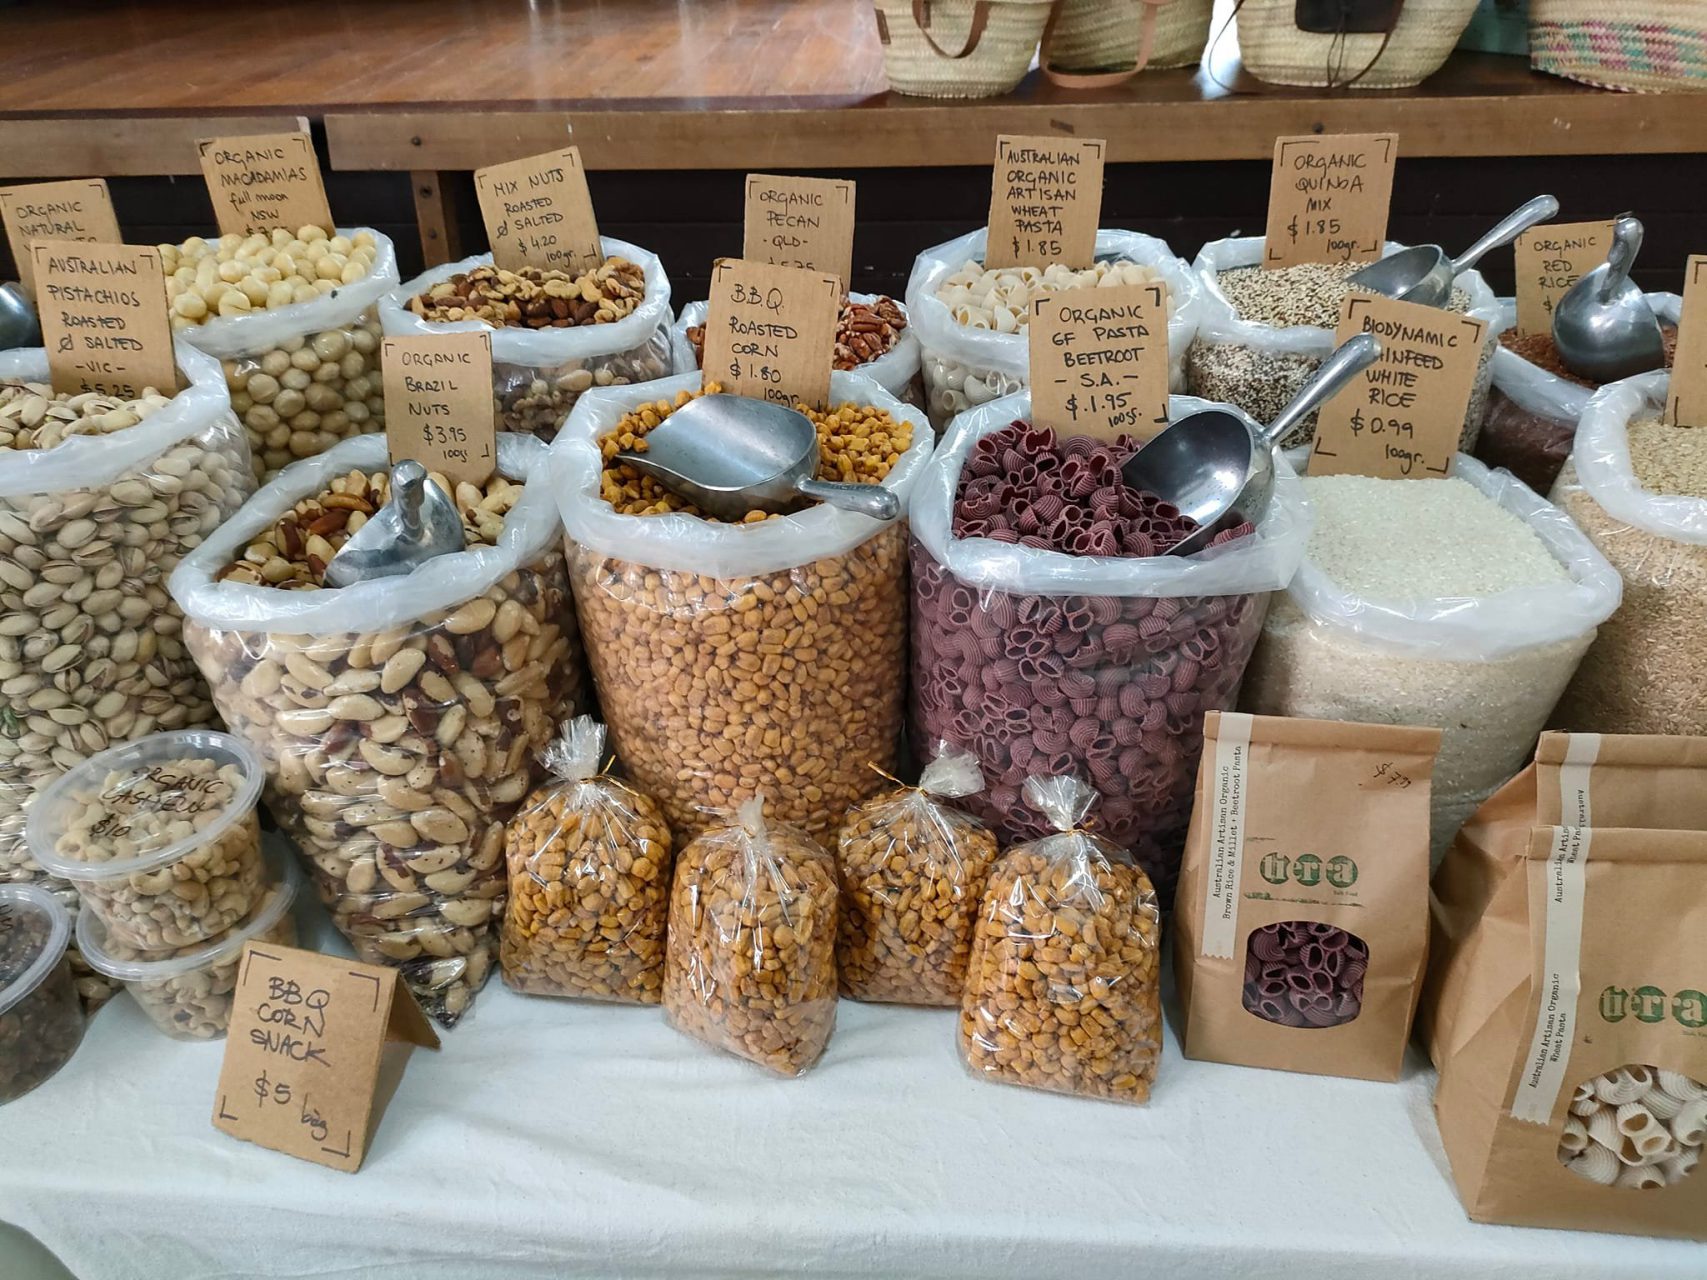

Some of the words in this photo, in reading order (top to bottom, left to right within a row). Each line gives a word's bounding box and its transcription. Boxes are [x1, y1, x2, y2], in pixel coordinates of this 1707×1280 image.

[215, 149, 285, 170] ORGANIC
[1007, 149, 1080, 166] AUSTRALIAN
[1294, 153, 1366, 177] ORGANIC
[221, 167, 307, 187] MACADAMIAS
[493, 180, 519, 197] MIX
[528, 168, 564, 189] NUTS
[1006, 170, 1077, 189] ORGANIC
[1295, 175, 1364, 194] QUINOA
[230, 190, 252, 212] full
[256, 192, 289, 203] moon
[759, 190, 823, 216] ORGANIC
[1006, 186, 1076, 201] ARTISAN
[16, 201, 83, 222] ORGANIC
[250, 209, 280, 221] NSW
[504, 197, 553, 217] ROASTED
[1011, 205, 1064, 218] WHEAT
[1306, 198, 1331, 213] MIX
[18, 221, 86, 237] NATURAL
[514, 213, 564, 230] SALTED
[766, 210, 820, 228] PECAN
[1014, 219, 1063, 235] PASTA
[1533, 237, 1597, 258] ORGANIC
[48, 256, 137, 275] AUSTRALIAN
[1542, 260, 1572, 273] RED
[1538, 275, 1580, 290] RICE
[46, 284, 141, 307] PISTACHIOS
[61, 311, 126, 330] ROASTED
[1059, 305, 1144, 324] ORGANIC
[729, 315, 798, 339] ROASTED
[1052, 332, 1076, 346] GF
[1092, 325, 1149, 341] PASTA
[1362, 315, 1458, 348] BIODYNAMIC
[84, 336, 143, 351] SALTED
[731, 342, 778, 358] CORN
[402, 352, 471, 367] ORGANIC
[1063, 347, 1145, 368] BEETROOT
[1379, 347, 1444, 370] INFEED
[405, 376, 458, 392] BRAZIL
[1366, 369, 1419, 388] WHITE
[1369, 387, 1417, 408] RICE
[408, 402, 450, 416] NUTS
[1233, 746, 1241, 771] Pasta
[132, 767, 224, 794] ORGANIC
[1219, 766, 1229, 805] Organic
[1230, 774, 1240, 815] Beetroot
[89, 813, 132, 837] $10
[1217, 807, 1227, 844] Artisan
[1227, 826, 1237, 857] Millet
[1212, 846, 1224, 898] Australian
[1225, 869, 1234, 890] Rice
[1222, 892, 1232, 920] Brown
[268, 976, 330, 1010] BBQ
[257, 1003, 325, 1038] CORN
[1529, 1048, 1548, 1089] Australian
[1541, 1013, 1555, 1048] Artisan
[1548, 973, 1560, 1012] Organic
[1556, 1013, 1566, 1039] Pasta
[250, 1029, 331, 1067] SNACK
[1550, 1039, 1563, 1063] Wheat
[254, 1069, 291, 1108] $5
[301, 1092, 328, 1141] bag
